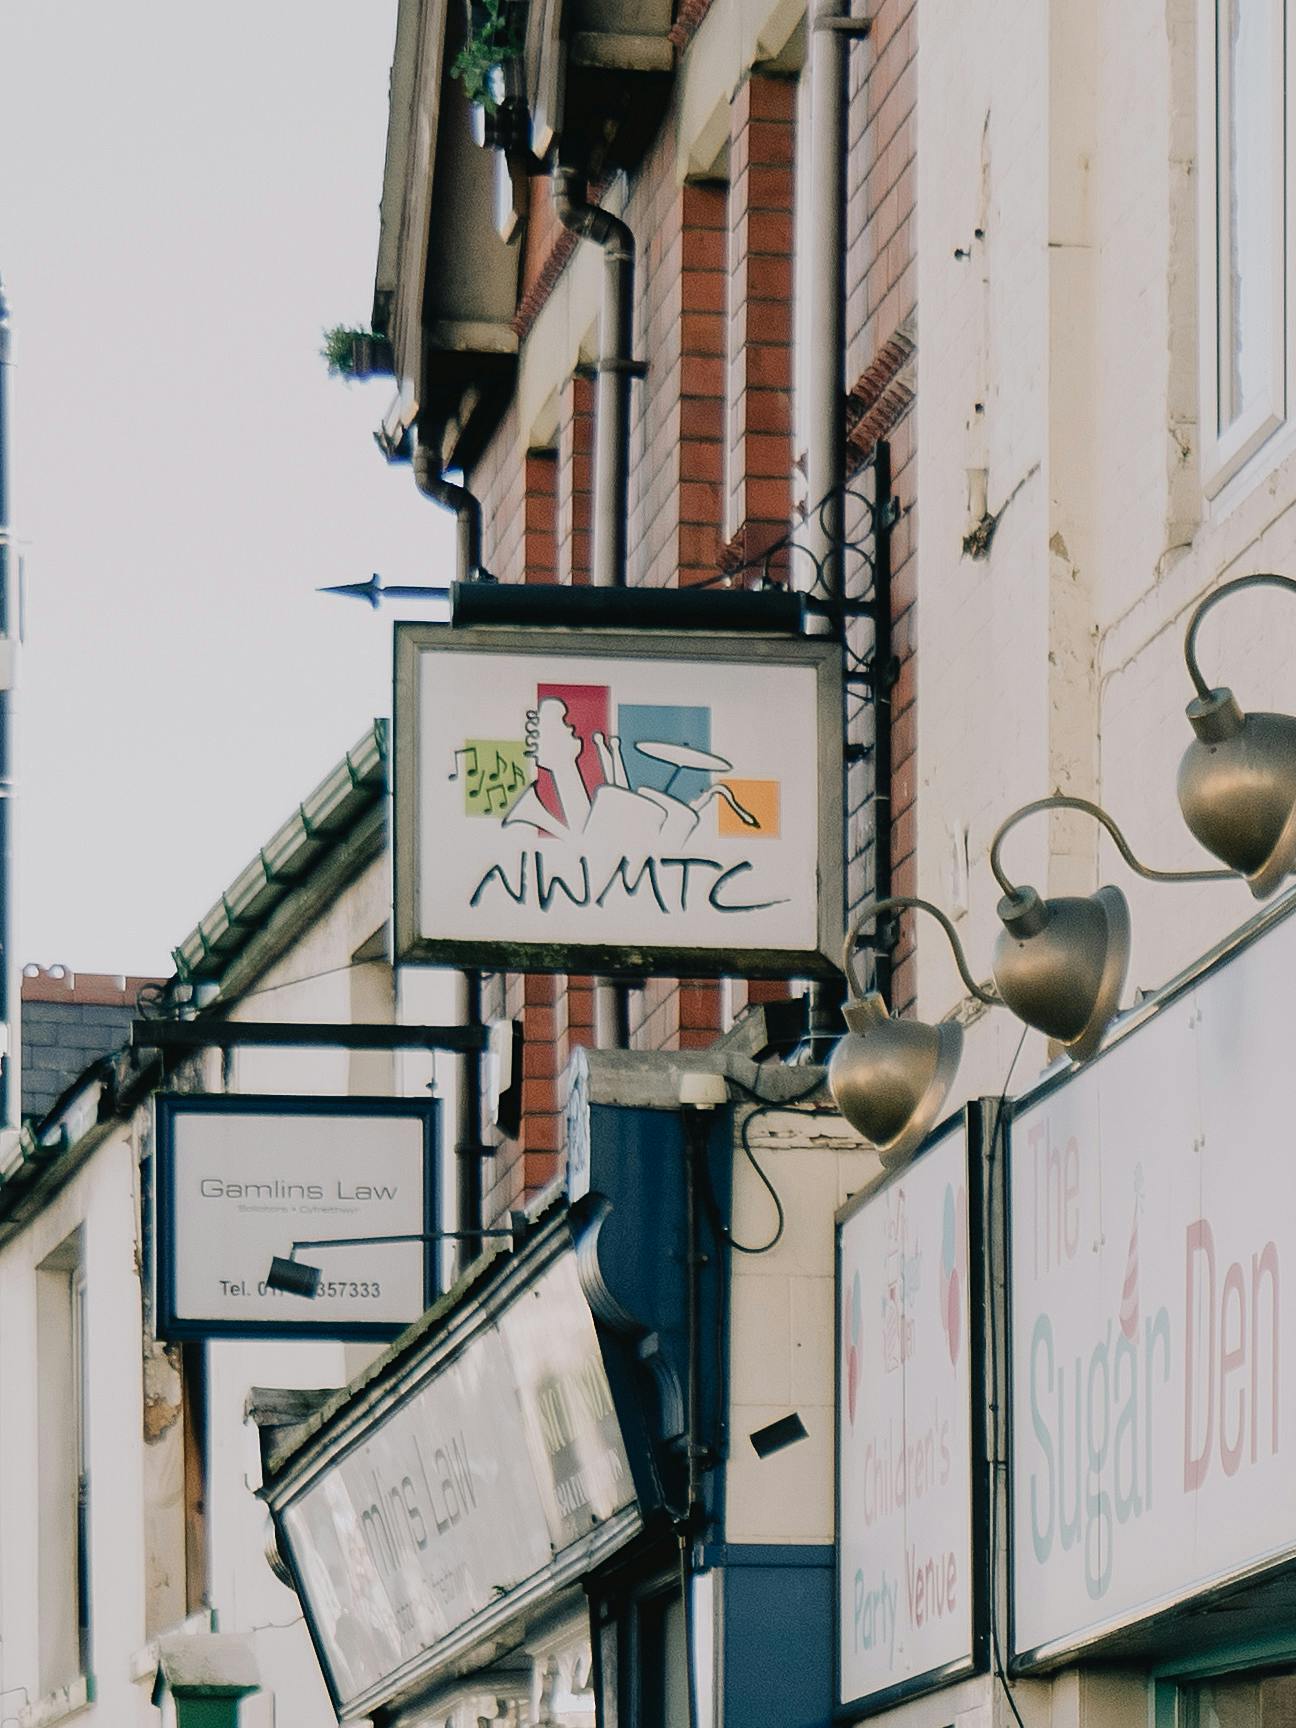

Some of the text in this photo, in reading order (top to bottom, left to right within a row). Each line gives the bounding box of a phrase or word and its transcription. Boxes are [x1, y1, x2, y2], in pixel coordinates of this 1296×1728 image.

[469, 850, 793, 914] NWMTC
[200, 1178, 398, 1201] Gamlins Law
[1027, 1117, 1081, 1280] The
[219, 1280, 251, 1297] Tel.
[863, 1397, 950, 1528] Children's
[1029, 1217, 1281, 1601] Sugar Den
[361, 1466, 429, 1577] mlins
[854, 1545, 957, 1670] Party Venue
